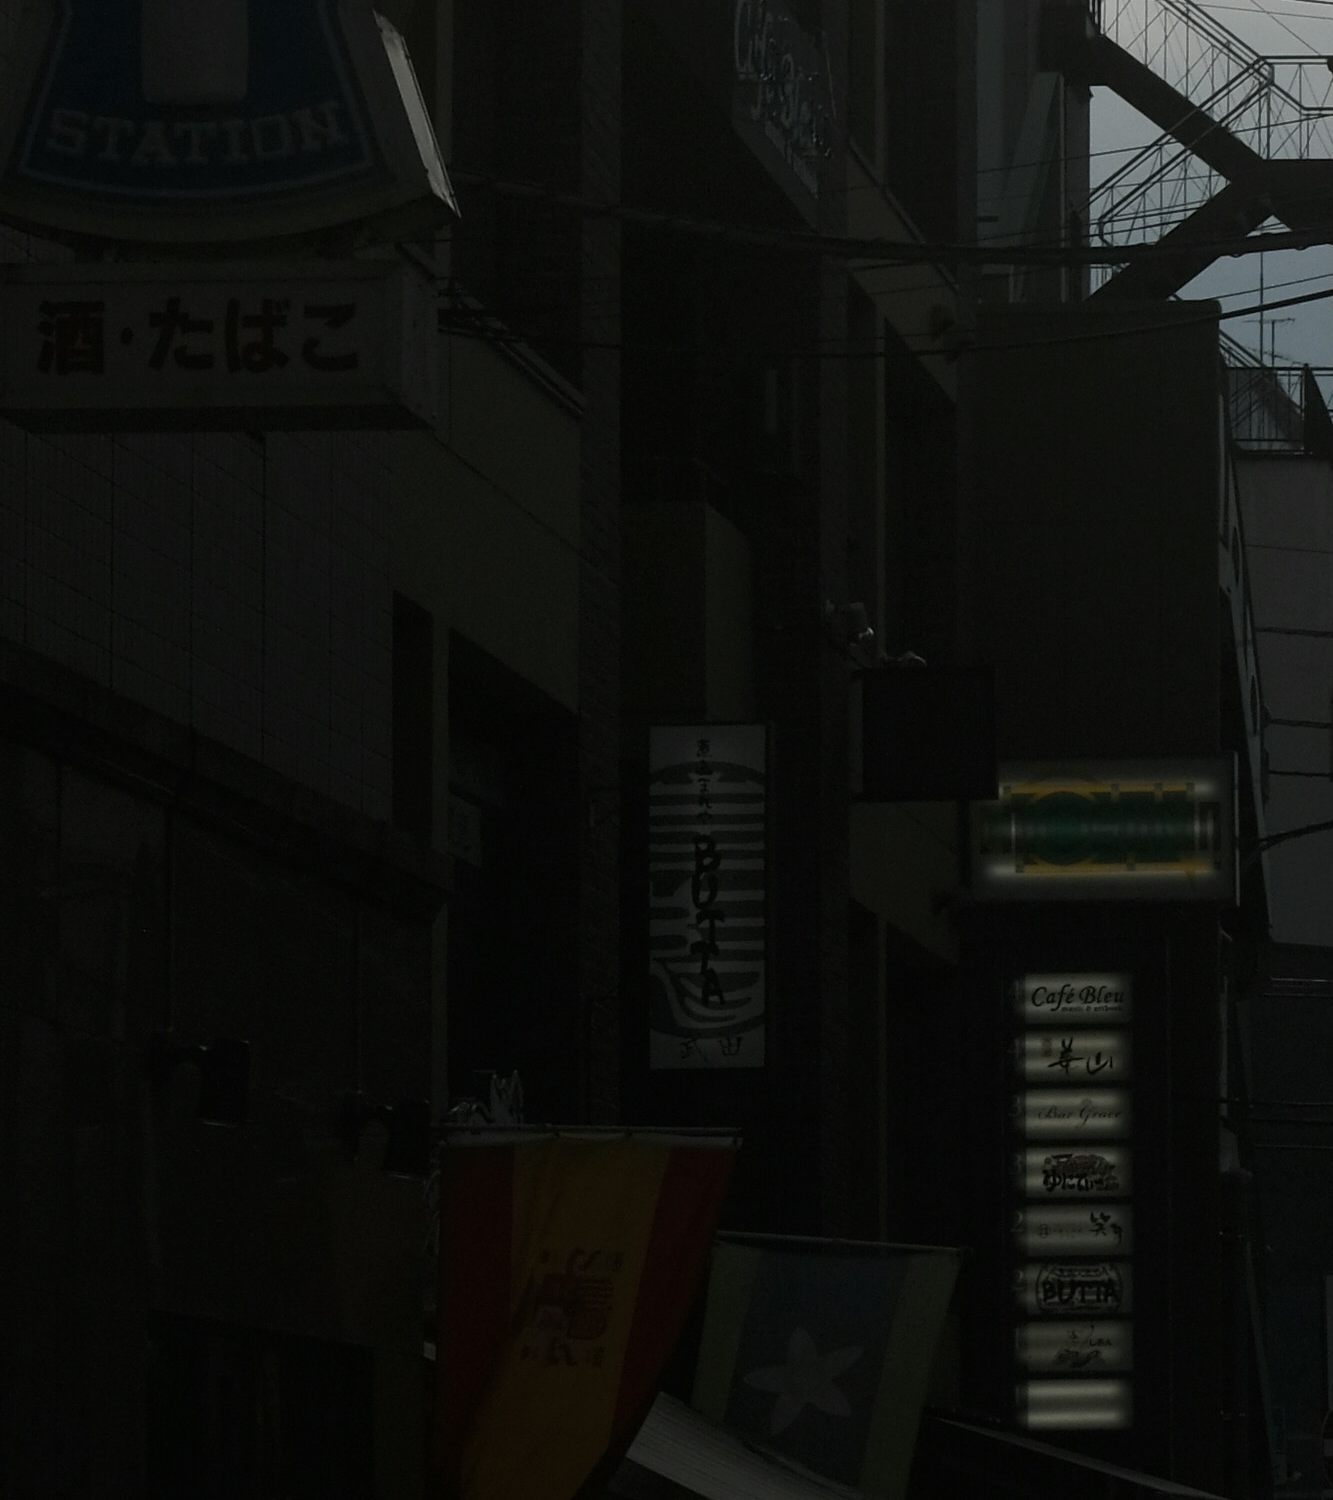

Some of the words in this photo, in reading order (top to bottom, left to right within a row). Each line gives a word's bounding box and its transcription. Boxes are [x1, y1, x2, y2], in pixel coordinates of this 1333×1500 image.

[47, 100, 349, 168] STATION
[690, 833, 726, 1007] BUTTA
[1031, 983, 1074, 1012] Café
[1079, 985, 1126, 1005] Bleu
[1042, 1278, 1120, 1304] BUTTA
